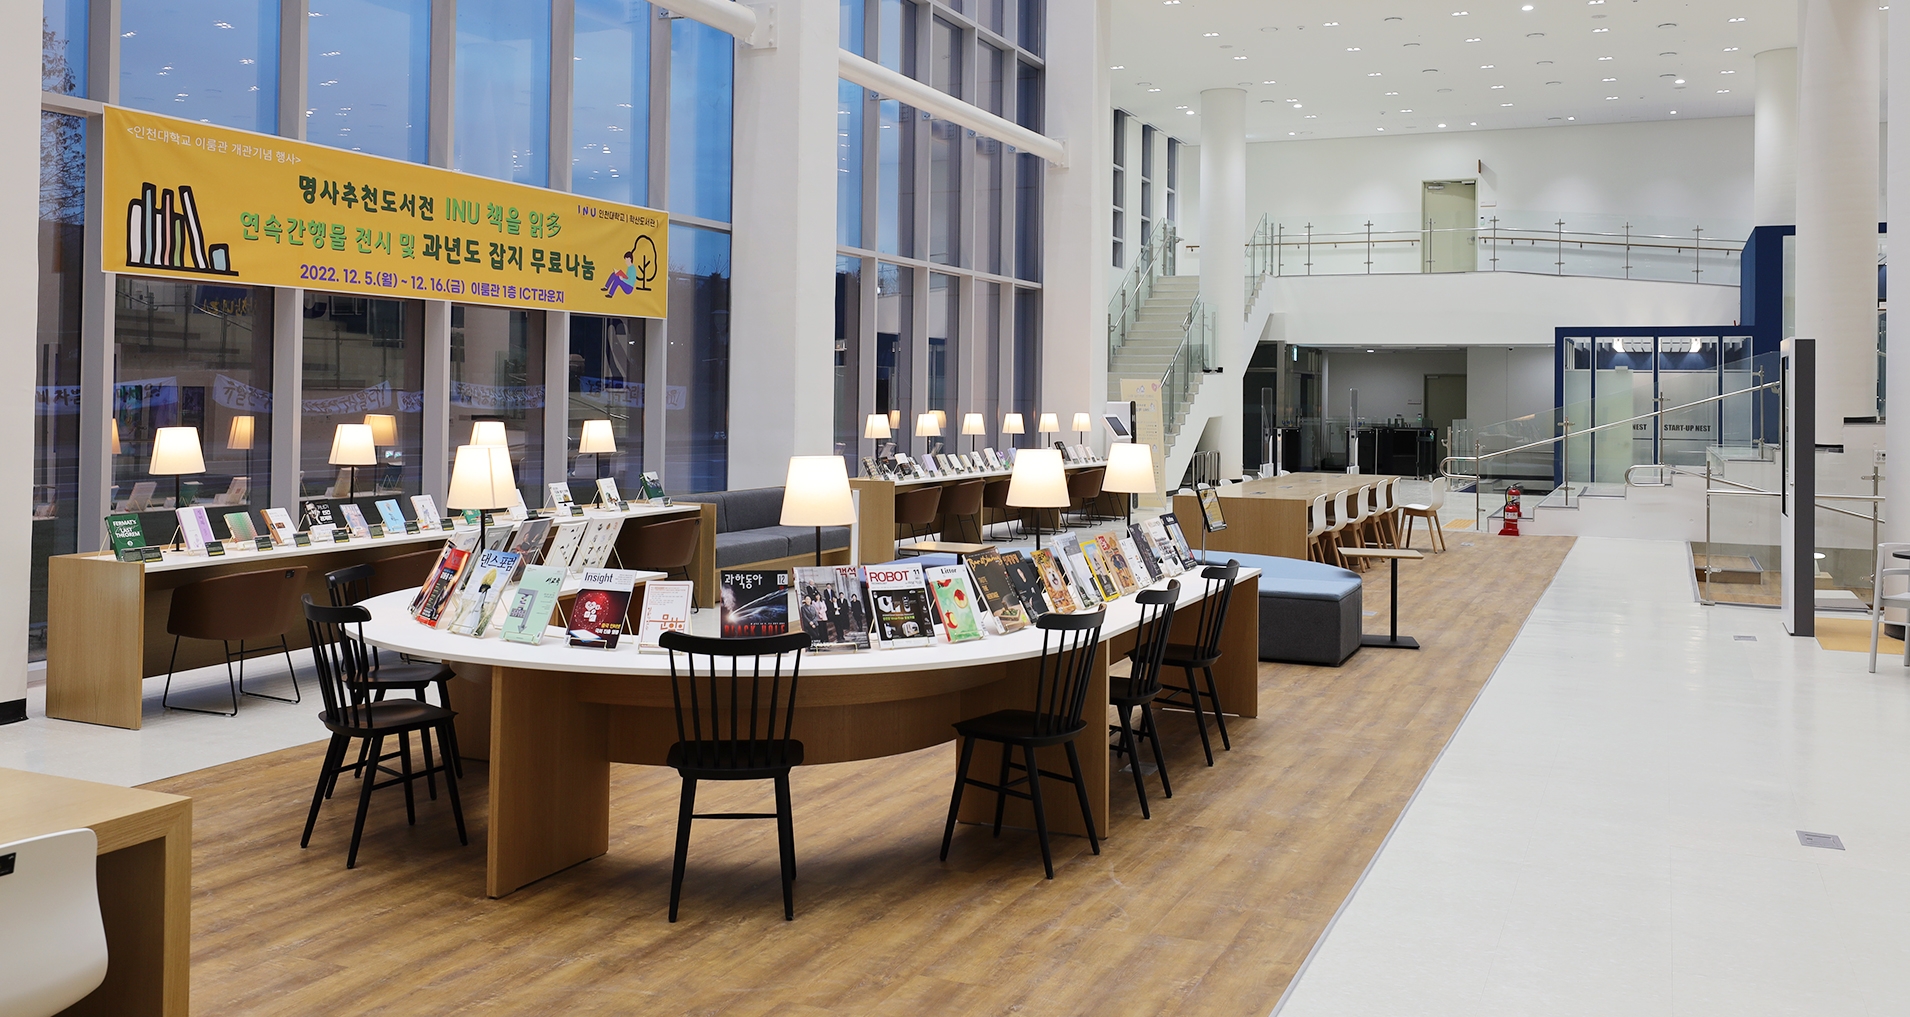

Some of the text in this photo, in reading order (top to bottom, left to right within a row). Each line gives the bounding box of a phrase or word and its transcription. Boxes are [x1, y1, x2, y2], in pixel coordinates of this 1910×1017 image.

[127, 126, 301, 165] <인천대학교 이룸관 개관기념 행사>
[299, 176, 434, 221] 명사추천도서전
[446, 198, 480, 224] INU
[486, 202, 522, 235] 책을
[578, 204, 656, 228] INU 인천대학교 학산도서관
[240, 212, 596, 280] 연속간행물 전시 및 과년도 잡지 무료나눔
[300, 264, 339, 283] 2022.
[344, 268, 361, 284] 12.
[411, 276, 427, 292] 12.
[471, 282, 500, 298] 이룸관
[503, 286, 516, 300] 1층
[520, 288, 565, 304] ICT라운지
[480, 553, 518, 572] 댄스포럼
[584, 572, 614, 584] Insight
[724, 574, 786, 590] 과학동아 12
[869, 570, 909, 582] ROBOT
